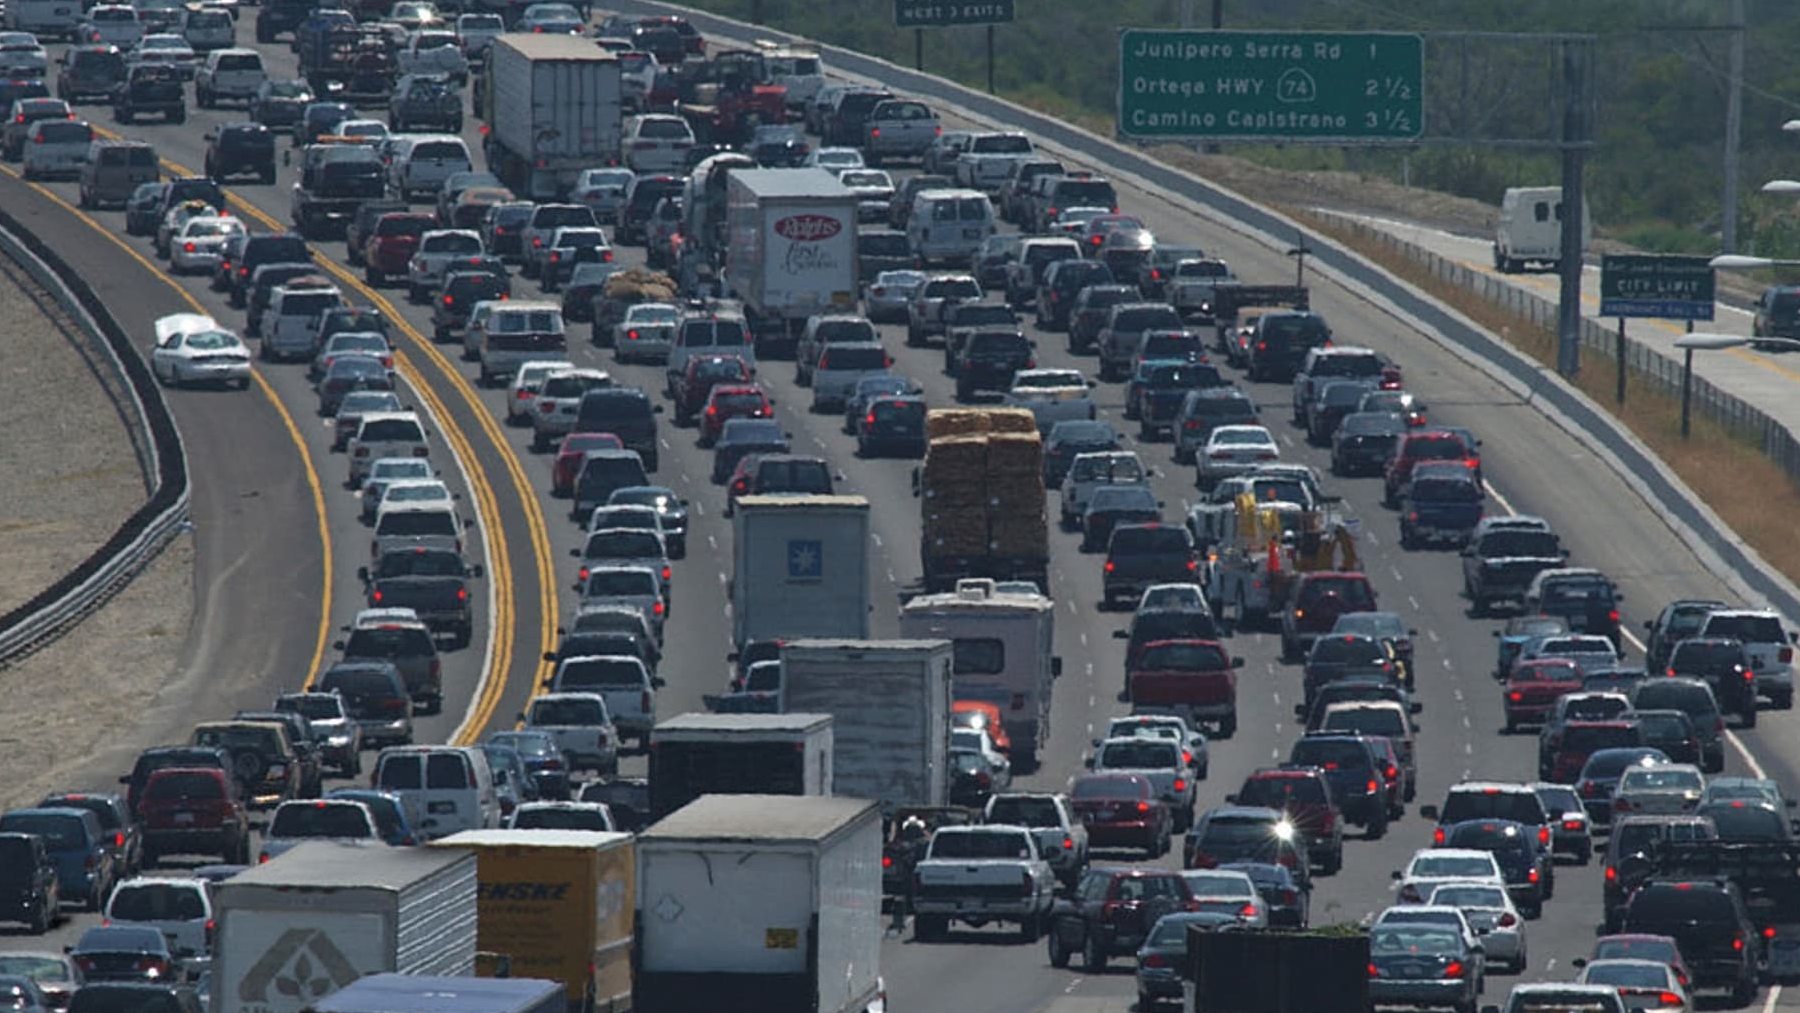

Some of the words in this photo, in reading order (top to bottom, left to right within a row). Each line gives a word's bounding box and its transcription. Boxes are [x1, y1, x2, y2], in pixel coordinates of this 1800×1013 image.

[1134, 41, 1232, 60] Junipero
[1246, 42, 1302, 58] Serra
[1314, 42, 1341, 59] Rd
[1134, 77, 1206, 97] Ortega
[1217, 77, 1264, 94] HWY
[1285, 79, 1308, 96] 74
[1133, 109, 1216, 127] Camino
[1227, 110, 1347, 127] Capistrano
